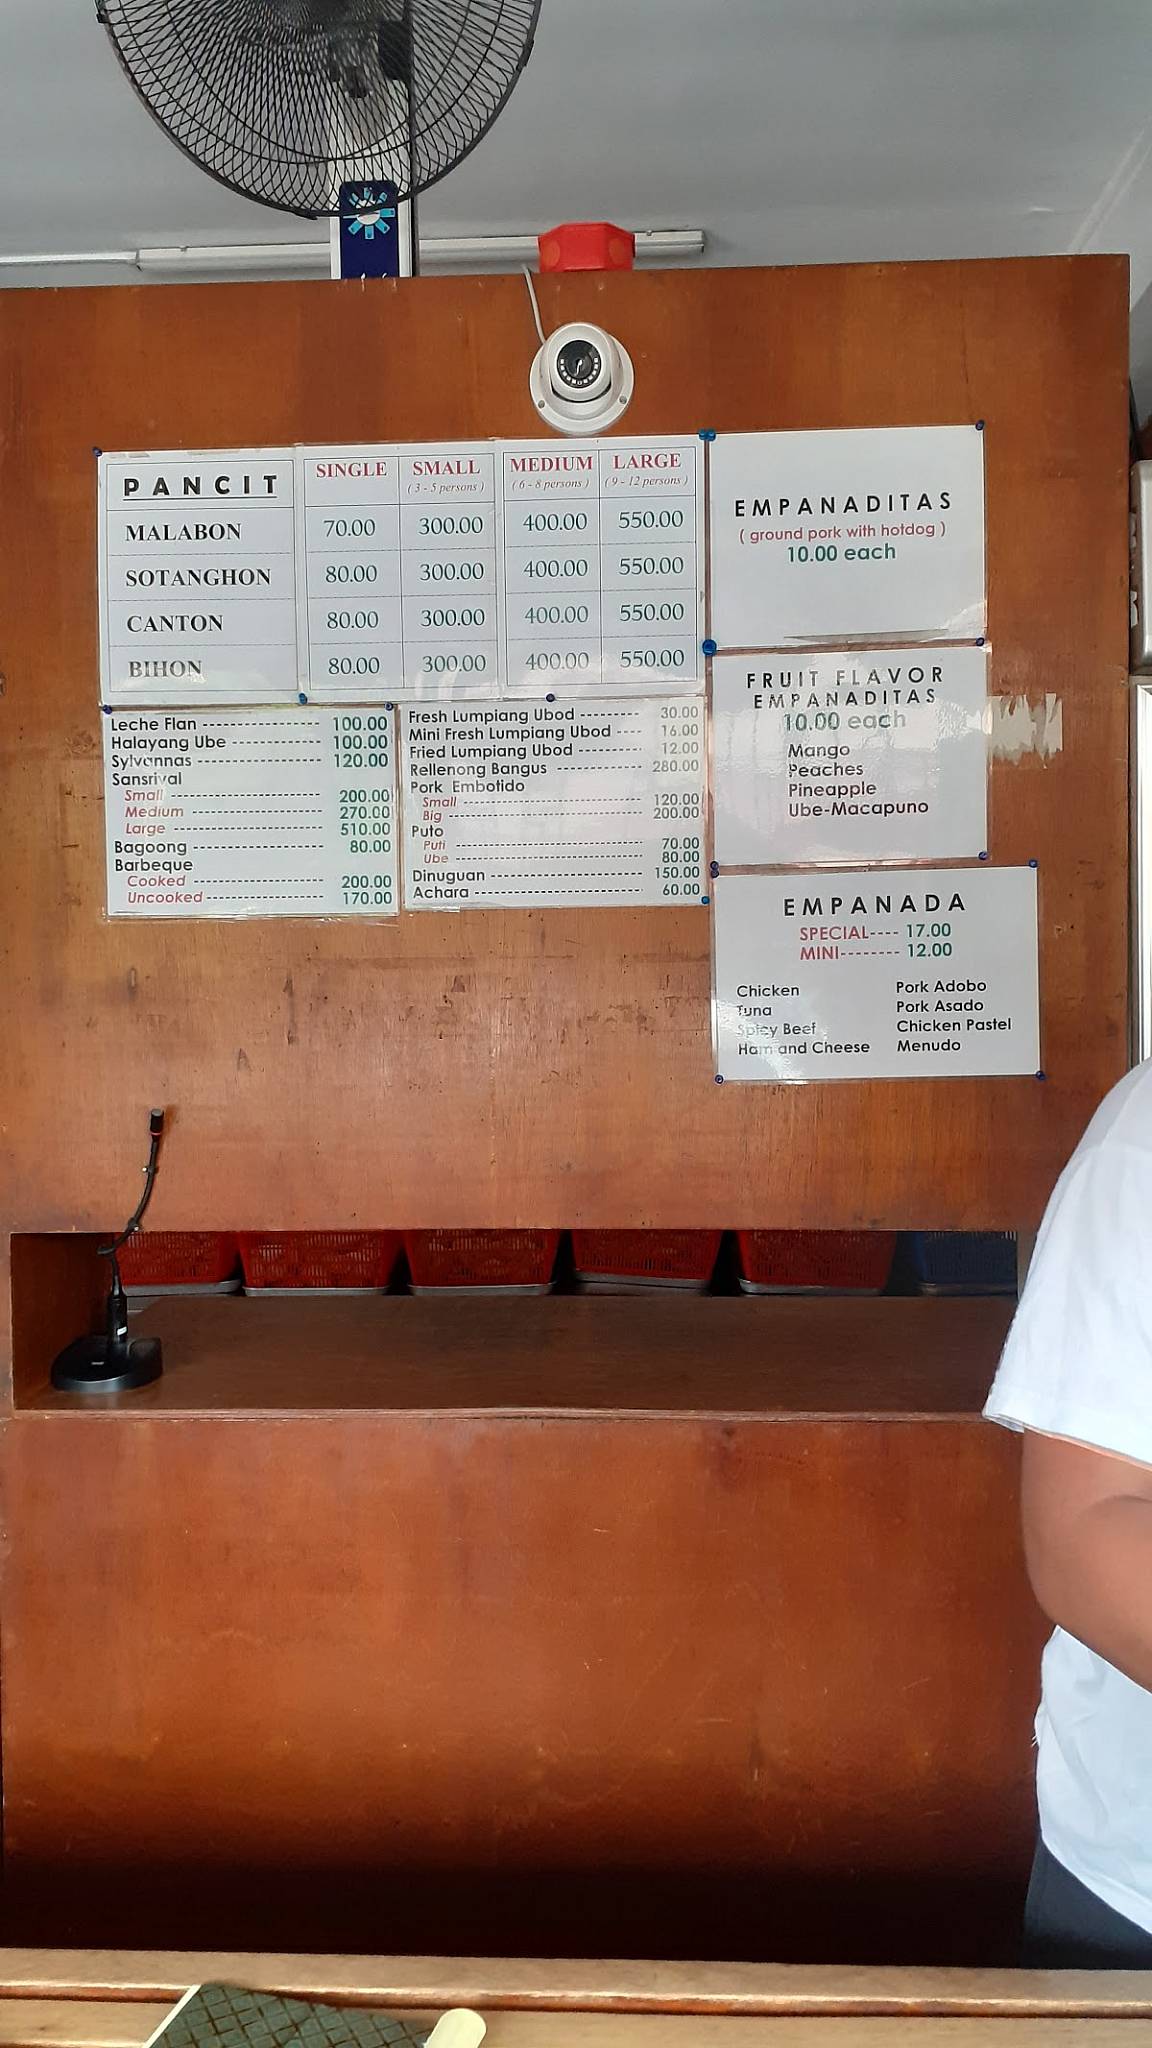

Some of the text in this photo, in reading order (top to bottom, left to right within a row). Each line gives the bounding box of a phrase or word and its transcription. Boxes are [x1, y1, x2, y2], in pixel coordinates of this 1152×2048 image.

[413, 460, 480, 476] SMALL
[510, 456, 593, 472] MEDIUM
[613, 454, 682, 469] LARGE
[316, 462, 387, 478] SINGLE
[124, 475, 277, 496] PANCIT
[414, 484, 420, 493] 3
[431, 484, 437, 492] 5
[439, 484, 478, 494] persons
[519, 480, 525, 489] 6
[535, 479, 542, 488] 8
[543, 480, 583, 491] persons
[611, 477, 617, 486] 9
[629, 476, 641, 486] 12
[643, 477, 681, 487] persons
[735, 492, 951, 517] EMPANADITAS
[125, 510, 684, 542] MALABON 70.00 300.00 400.00 550.00
[750, 527, 803, 543] ground
[808, 526, 842, 542] pork
[847, 524, 876, 539] with
[881, 523, 935, 539] hotdog
[787, 544, 896, 563] 10.00 each
[125, 556, 684, 587] SOTANGHON 80.00 300.00 400.00 550.00
[127, 603, 684, 633] CANTON 80.00 300.00 400.00 550.00
[128, 650, 685, 678] BIHON 80.00 300.00 400.00 550.00
[747, 667, 943, 689] FRUIT FLAVOR
[754, 689, 936, 709] EMPANADITAS
[409, 707, 699, 726] Fresh Lumpiang Ubod 30.00
[783, 711, 906, 731] 10.00 each
[111, 717, 388, 732] Leche Flan 100.00
[409, 724, 699, 743] Mini Fresh Lumpiang Ubod 16.00
[111, 735, 388, 752] Halayang Ube 100.00
[410, 742, 699, 761] Fried Lumpiang Ubod 12.00
[788, 744, 850, 759] Mango
[111, 753, 389, 770] Sylvannas 120.00
[410, 761, 699, 778] Rellenong Bangus 280.00
[788, 763, 864, 778] Peaches
[112, 773, 182, 786] Sansrival
[411, 780, 525, 794] Pork Embotido
[124, 790, 389, 803] Small 200.00
[788, 782, 877, 800] Pineapple
[423, 794, 700, 808] Small 120.00
[125, 806, 390, 819] Medium 270.00
[423, 807, 700, 823] Big 200.00
[789, 802, 929, 817] Ube-Macapuno
[126, 823, 391, 836] Large 510.00
[412, 825, 444, 838] Puto
[114, 840, 391, 856] Bagoong 80.00
[424, 838, 700, 851] Puti 70.00
[424, 851, 700, 864] Ube 80.00
[115, 858, 193, 873] Barbeque
[127, 875, 392, 888] Cooked 200.00
[413, 867, 700, 885] Dinuguan 150.00
[128, 892, 392, 905] Uncooked 170.00
[413, 884, 700, 899] Achara 60.00
[784, 894, 965, 916] EMPANADA
[906, 924, 951, 938] 17.00
[907, 943, 953, 958] 12.00
[737, 985, 800, 998] Chicken
[896, 980, 987, 994] Pork Adobo
[737, 1005, 772, 1017] Tuna
[896, 1000, 984, 1013] Pork Asado
[783, 1023, 816, 1035] Beef
[897, 1018, 1012, 1033] Chicken Pastel
[778, 1043, 807, 1054] and
[812, 1042, 870, 1053] Cheese
[897, 1039, 961, 1053] Menudo
